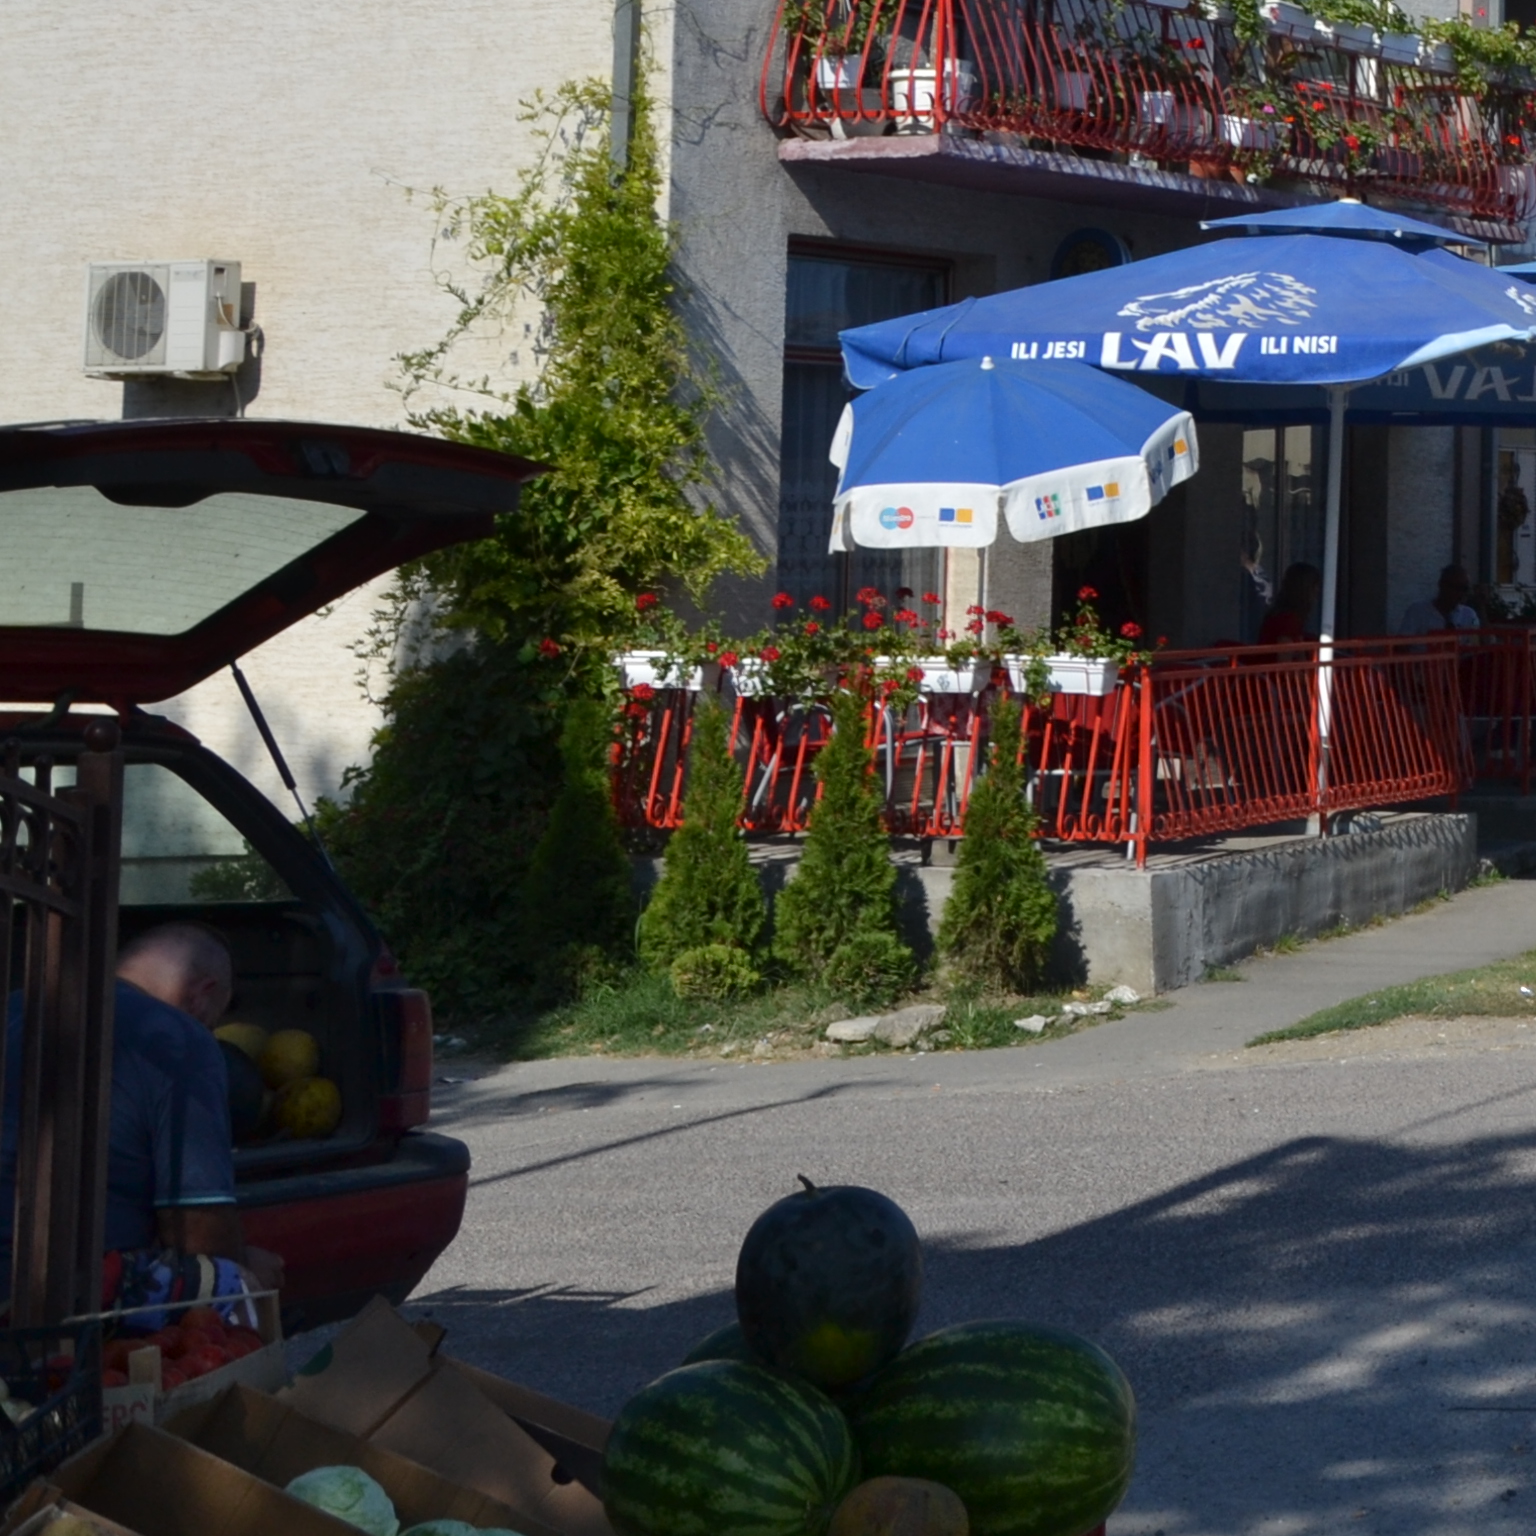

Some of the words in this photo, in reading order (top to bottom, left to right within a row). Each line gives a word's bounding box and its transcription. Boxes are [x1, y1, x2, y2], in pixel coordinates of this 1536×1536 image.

[1011, 342, 1037, 359] ILI
[1042, 340, 1086, 359] JESI
[1100, 331, 1248, 370] LAV
[1260, 337, 1288, 354] ILI
[1293, 335, 1338, 353] NISI
